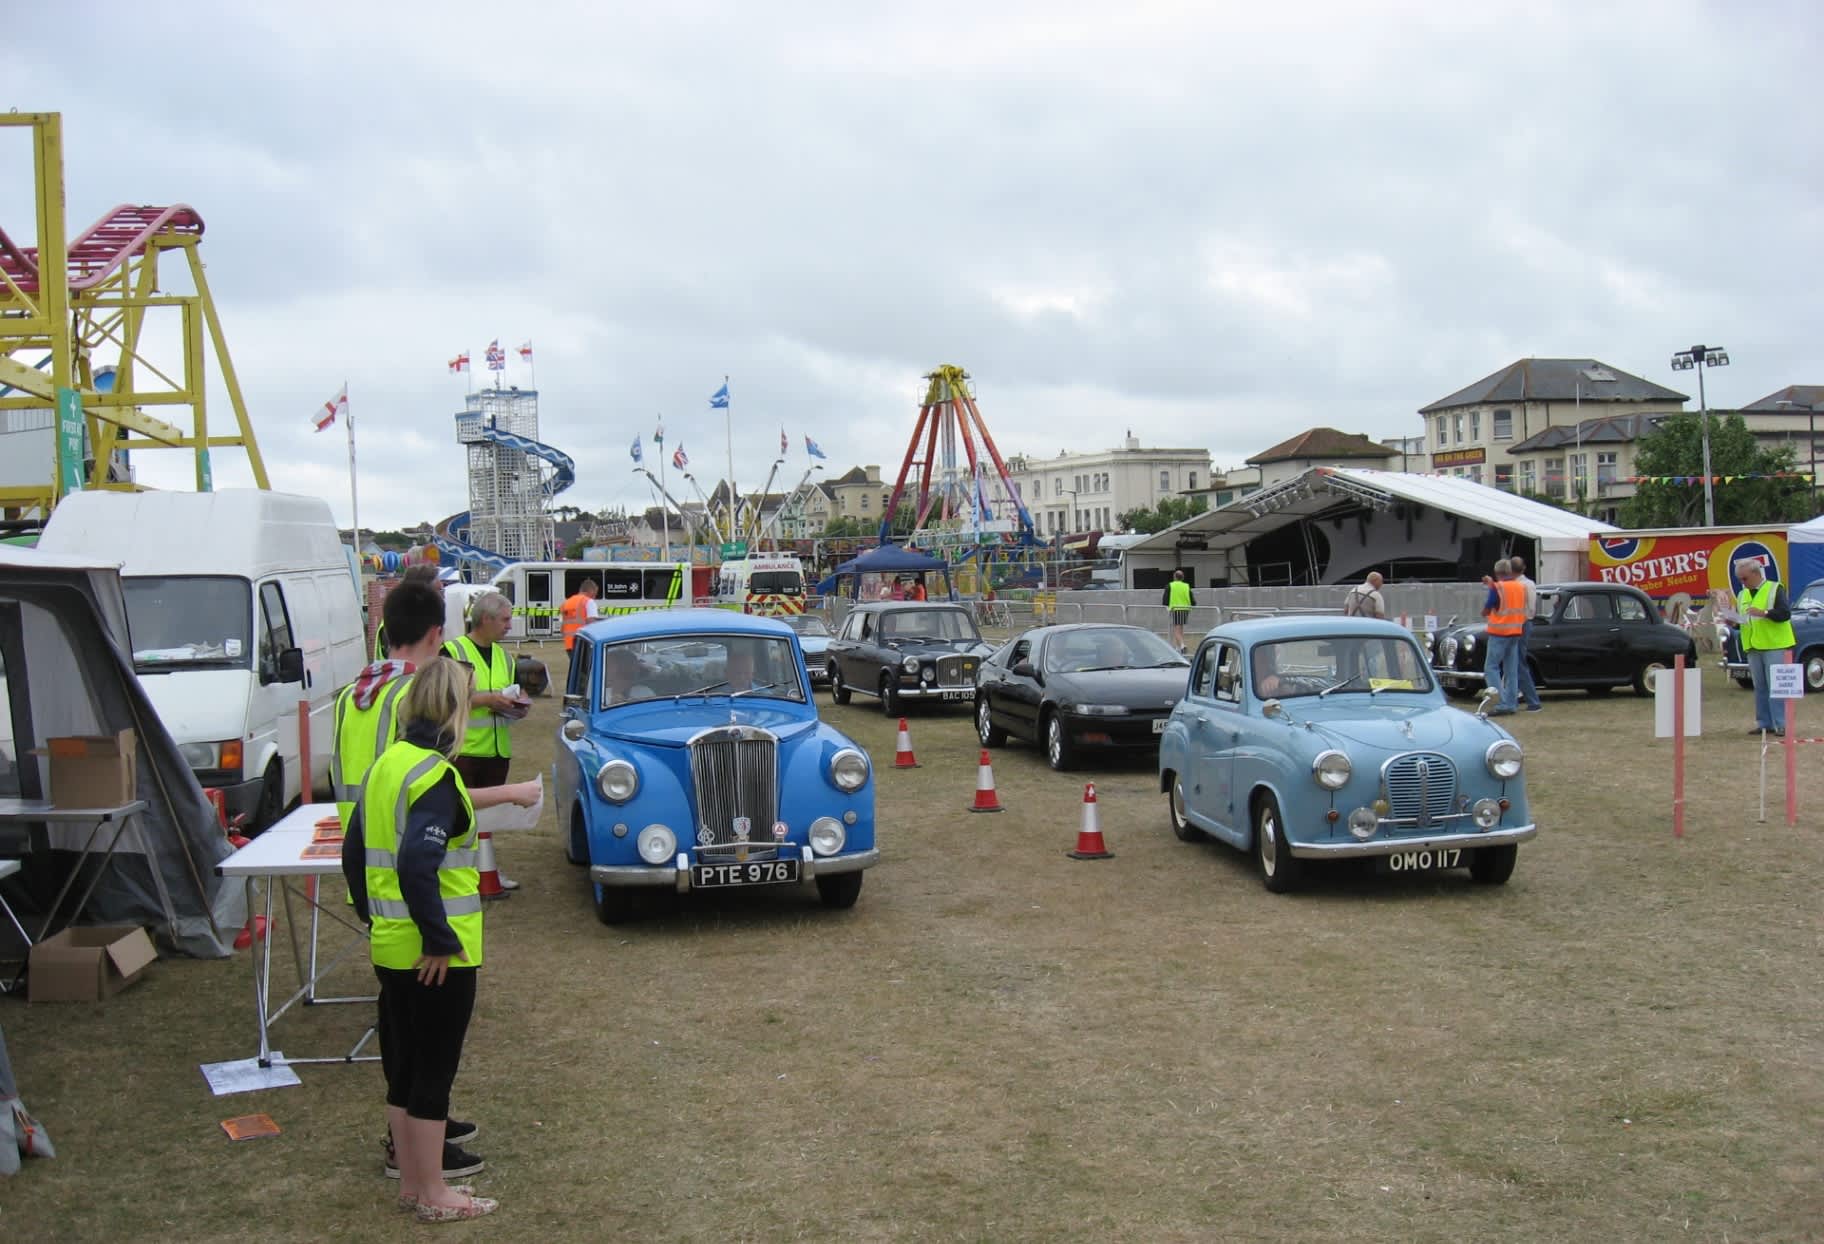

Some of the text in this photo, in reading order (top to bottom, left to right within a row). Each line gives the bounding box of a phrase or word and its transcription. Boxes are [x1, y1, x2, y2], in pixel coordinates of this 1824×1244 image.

[1600, 550, 1708, 585] FOSTER'S
[1667, 574, 1698, 587] Nectar
[1390, 849, 1461, 871] OMO 117
[701, 863, 788, 885] PTE 976
